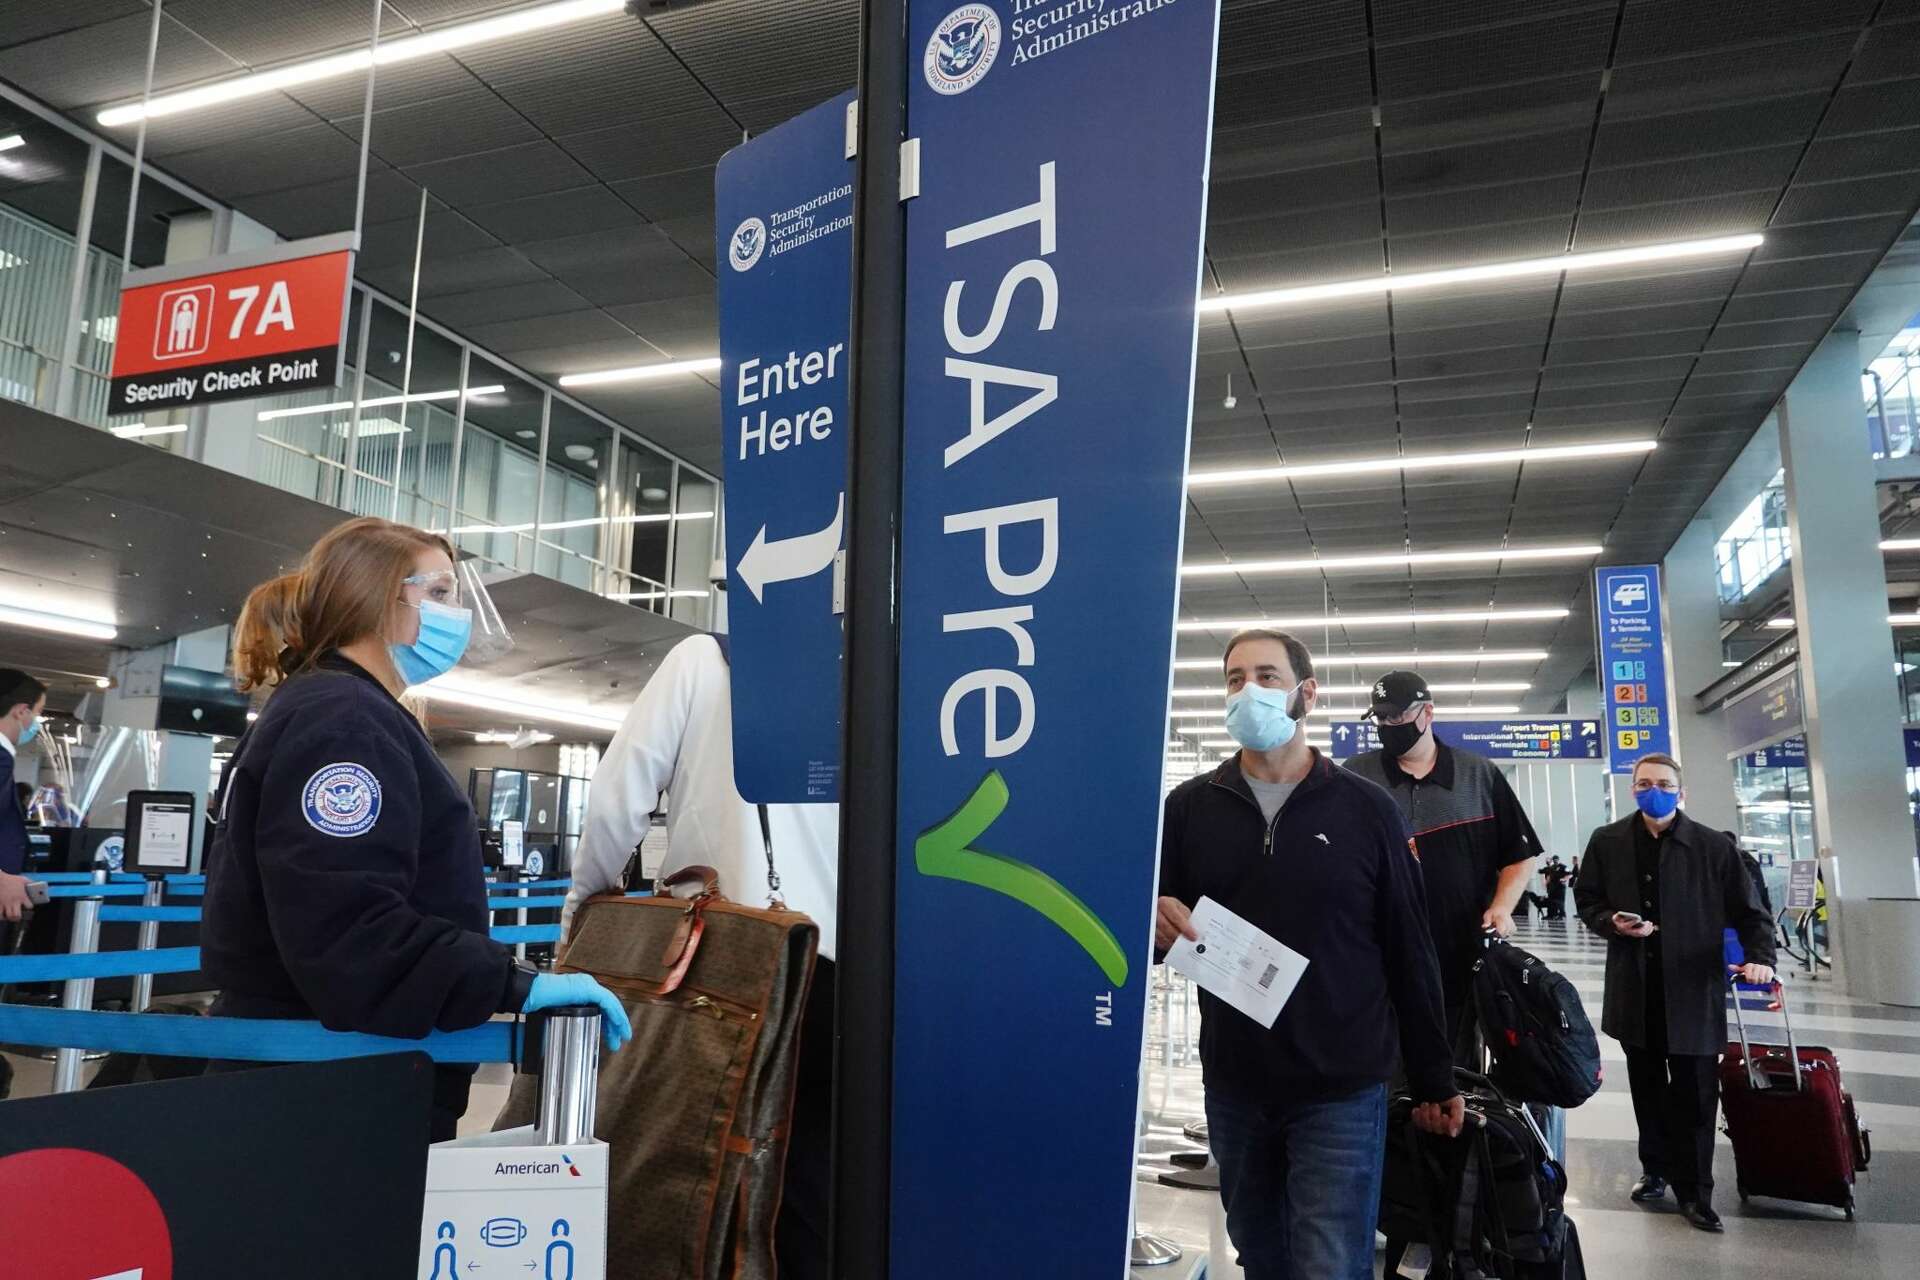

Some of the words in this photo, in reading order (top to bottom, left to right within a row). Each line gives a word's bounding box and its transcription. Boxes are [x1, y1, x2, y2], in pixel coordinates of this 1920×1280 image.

[940, 8, 992, 33] DEPARTMENT
[988, 19, 997, 30] OF
[1011, 0, 1104, 40] Security
[928, 65, 963, 91] HOMELAND
[967, 41, 997, 83] SECURITY
[770, 184, 852, 227] Transportation
[769, 215, 854, 258] Administration
[770, 215, 815, 242] Security
[228, 280, 295, 340] 7A
[943, 160, 1059, 469] TSA
[125, 376, 198, 404] Security
[203, 367, 262, 393] Check
[268, 358, 319, 384] Point
[738, 343, 843, 406] Enter
[740, 406, 833, 460] Here
[940, 497, 1059, 758] Pre
[1618, 664, 1627, 677] 1
[1620, 686, 1631, 700] 2
[1502, 724, 1530, 732] Airport
[1621, 709, 1631, 723] 3
[1512, 750, 1549, 758] Economy
[1623, 732, 1634, 746] 5
[355, 770, 379, 799] SECURITY
[1096, 991, 1112, 1025] TM
[495, 1161, 560, 1175] American
